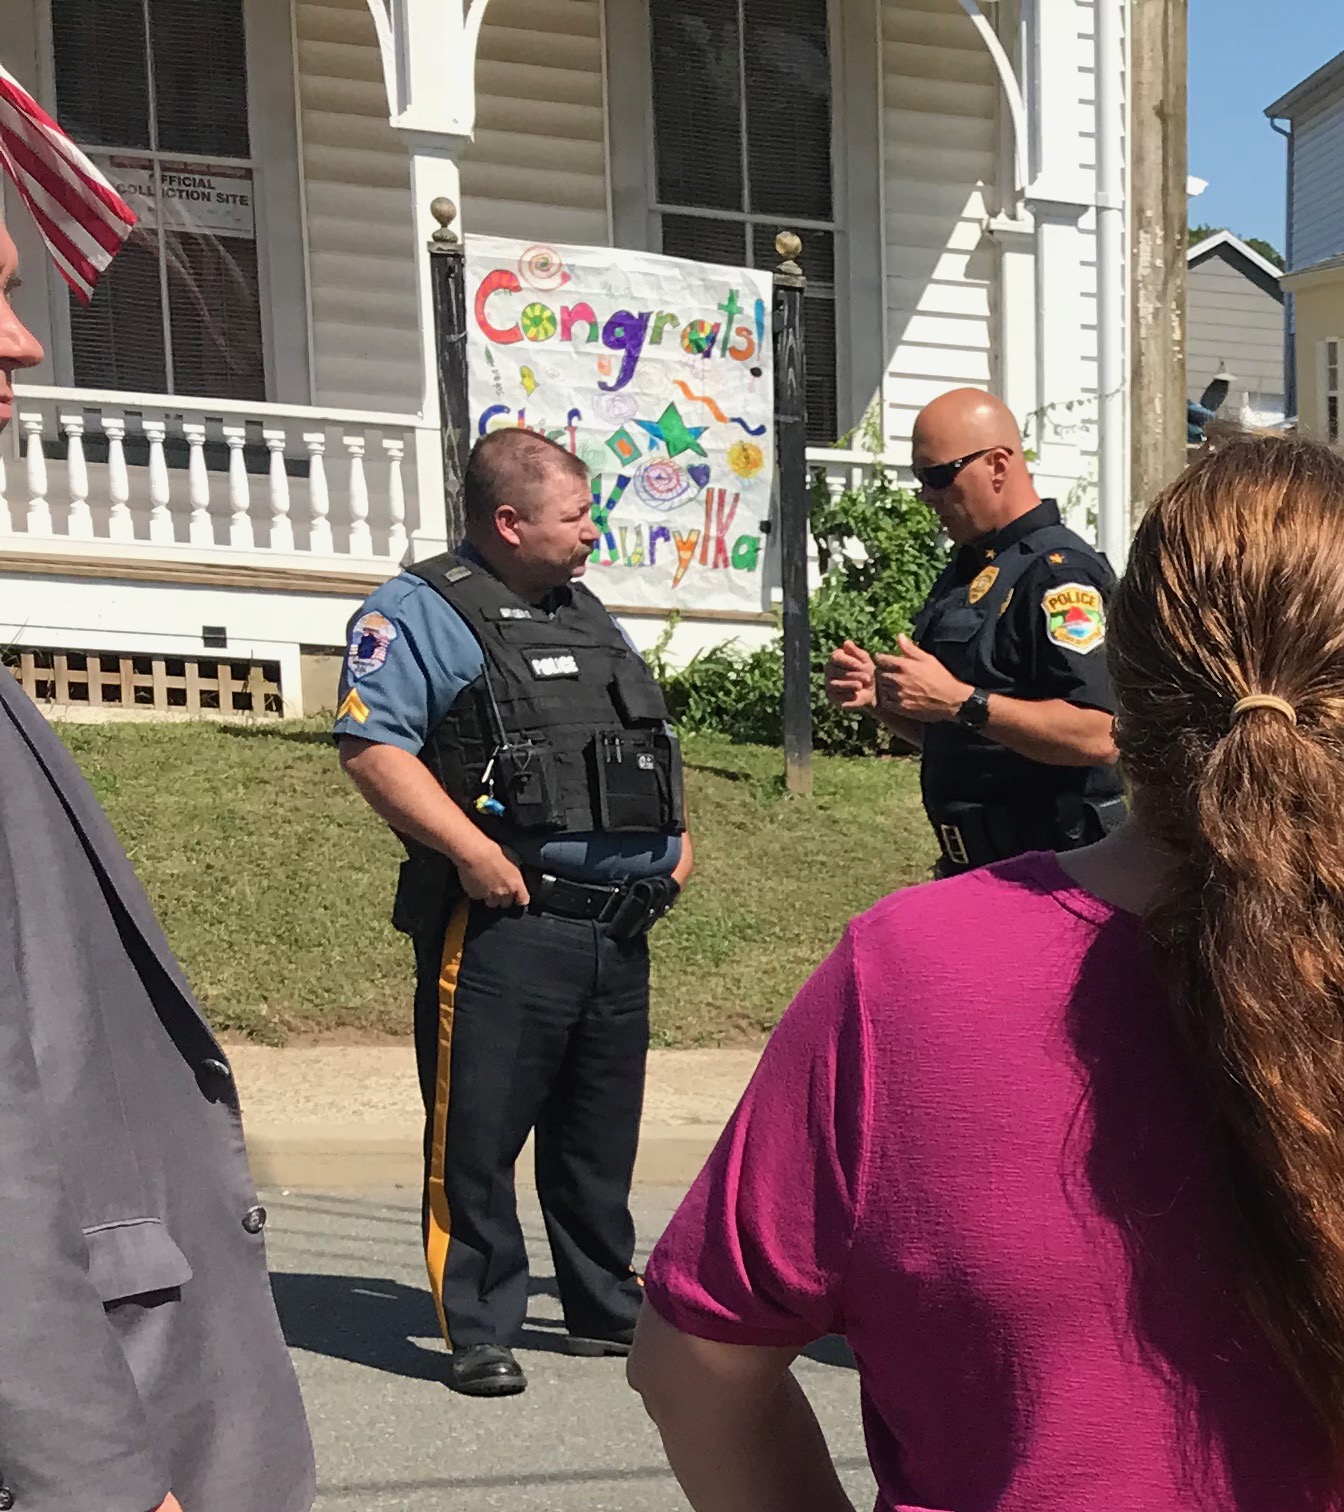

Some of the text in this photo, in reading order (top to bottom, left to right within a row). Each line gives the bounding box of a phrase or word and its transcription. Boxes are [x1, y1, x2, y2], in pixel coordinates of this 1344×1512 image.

[149, 173, 216, 190] FFICIAL
[115, 182, 249, 206] COLLCTION SITE
[474, 268, 765, 392] Congrats!
[1048, 591, 1097, 610] POLICE
[531, 655, 579, 676] POLICE
